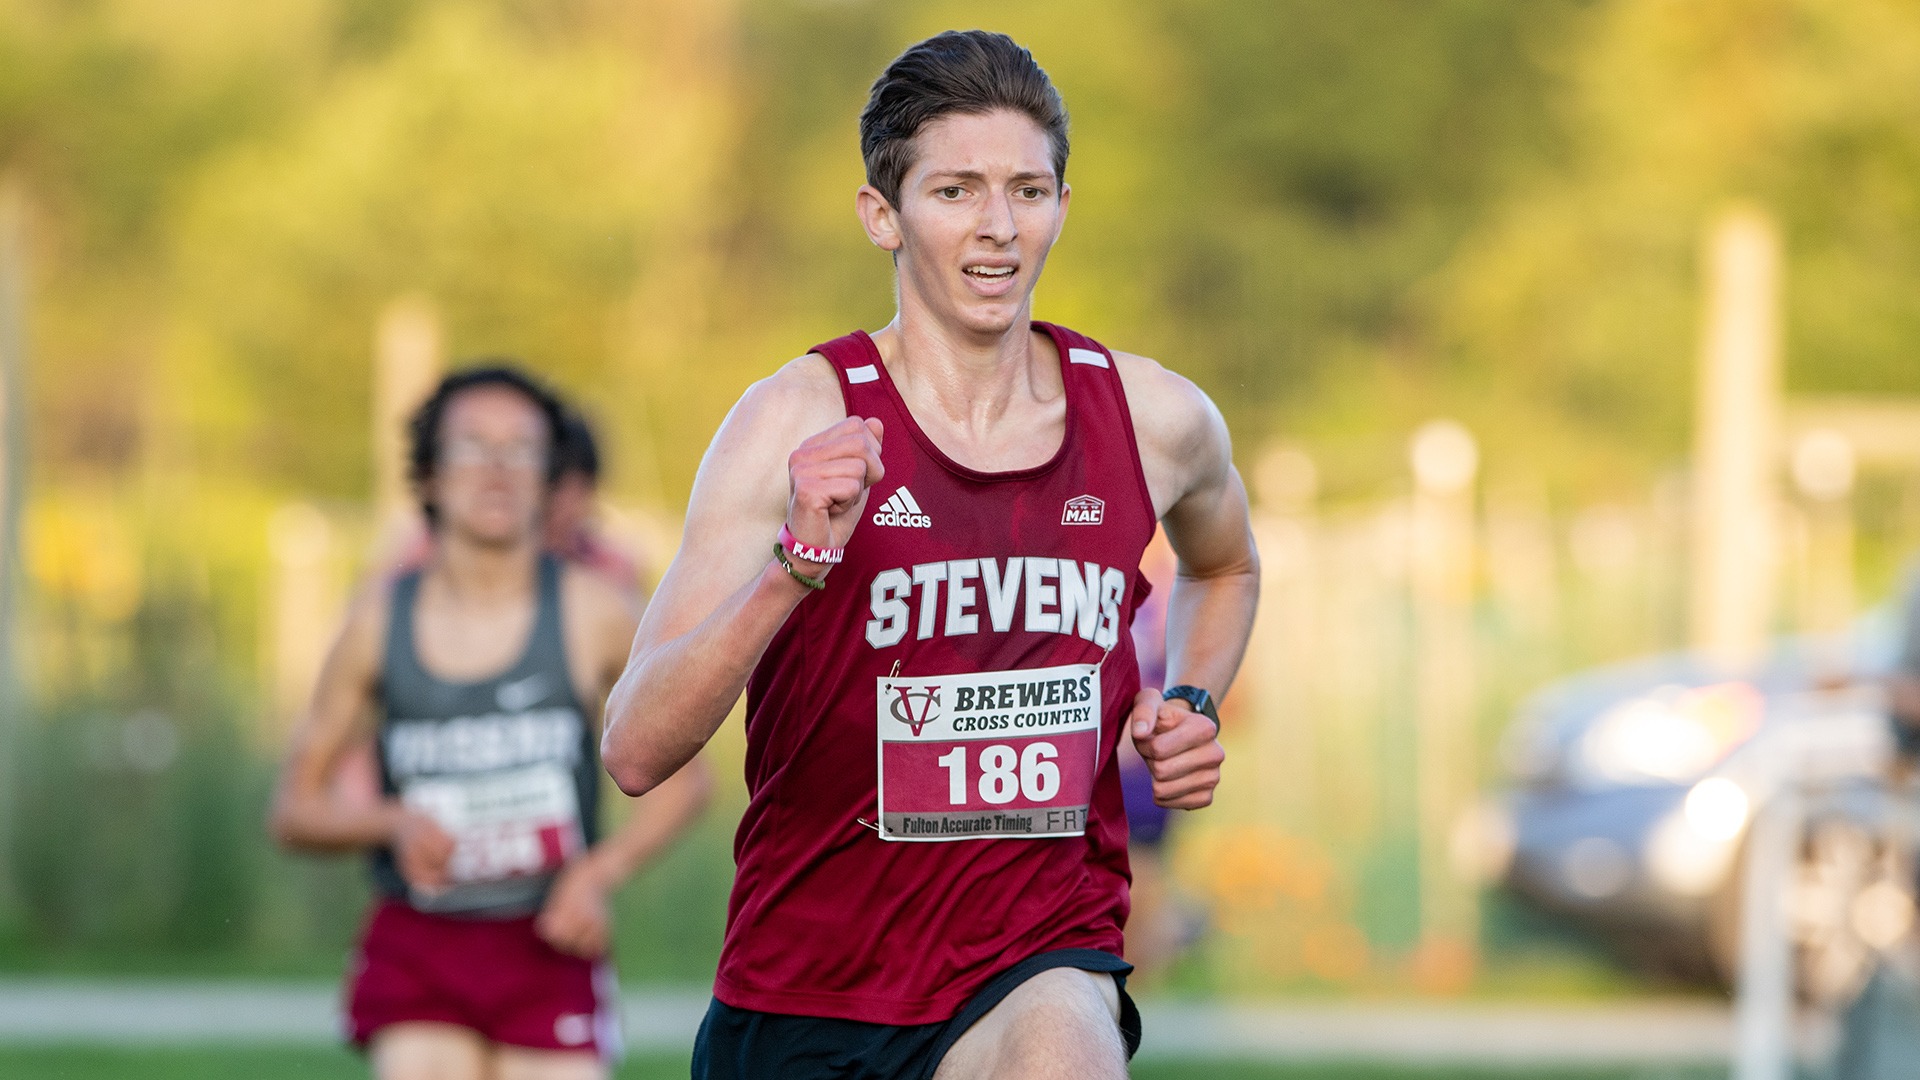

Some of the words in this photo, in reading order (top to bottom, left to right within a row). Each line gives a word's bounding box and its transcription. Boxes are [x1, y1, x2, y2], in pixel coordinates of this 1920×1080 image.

[873, 511, 932, 529] adidas
[1065, 509, 1101, 522] MAC
[865, 556, 1126, 651] STEVENS
[953, 676, 1092, 713] BREWERS
[952, 715, 1009, 732] CROSS
[1013, 706, 1092, 728] COUNTRY
[938, 741, 1061, 805] 186
[903, 816, 939, 834] Fulton
[940, 815, 992, 834] Accurate
[993, 814, 1033, 833] Timing
